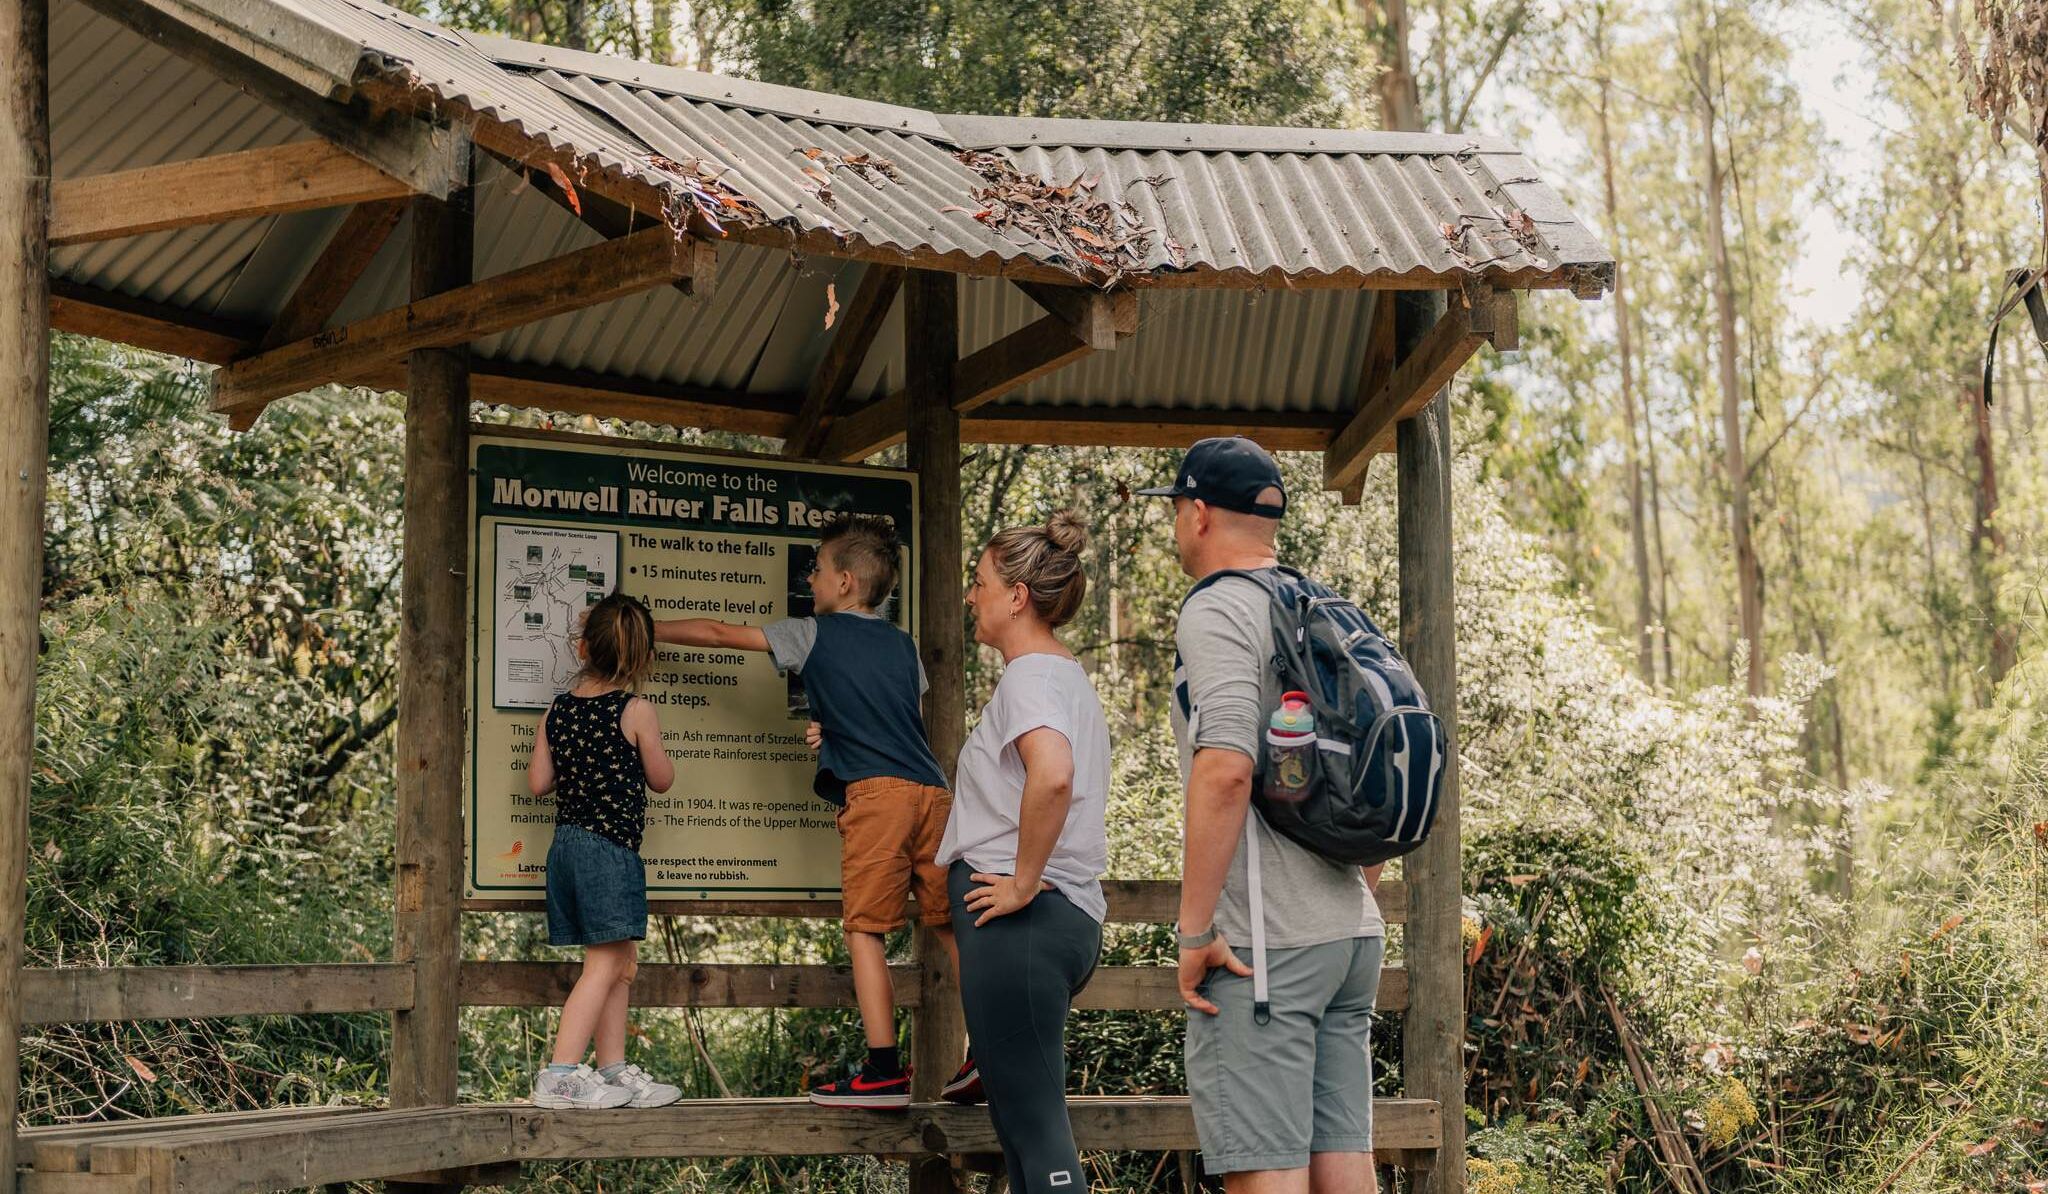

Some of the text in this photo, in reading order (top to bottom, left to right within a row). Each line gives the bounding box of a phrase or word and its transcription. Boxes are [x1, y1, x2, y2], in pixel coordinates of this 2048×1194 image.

[628, 463, 778, 493] Welcome to the
[493, 477, 619, 513] Morwell
[628, 488, 704, 519] River
[713, 495, 779, 525] Falls
[629, 533, 775, 556] The walk to the falls
[642, 564, 766, 585] 15 minutes return.
[641, 595, 773, 614] A moderate level of
[684, 652, 705, 663] are
[709, 652, 745, 665] some
[647, 672, 738, 686] teep sections
[672, 694, 710, 709] steps.
[511, 724, 534, 736] This
[683, 731, 703, 742] Ash
[706, 732, 751, 744] remnant
[754, 733, 766, 744] of
[768, 733, 809, 745] Strzelec
[664, 748, 710, 760] mperate
[714, 748, 767, 761] Rainforest
[770, 751, 808, 763] species
[510, 794, 532, 806] The
[674, 798, 684, 809] in
[687, 799, 716, 810] 1904.
[719, 799, 728, 810] It
[729, 802, 750, 811] was
[752, 801, 809, 814] re-opened
[811, 801, 821, 812] in
[664, 815, 685, 826] The
[687, 815, 727, 827] Friends
[729, 815, 742, 827] of
[743, 816, 761, 828] the
[764, 818, 797, 831] Upper
[800, 818, 836, 829] Morwe
[518, 863, 546, 872] Latro
[660, 857, 696, 868] respect
[698, 857, 714, 867] the
[716, 858, 777, 867] environment
[657, 870, 749, 881] & leave no rubbish.
